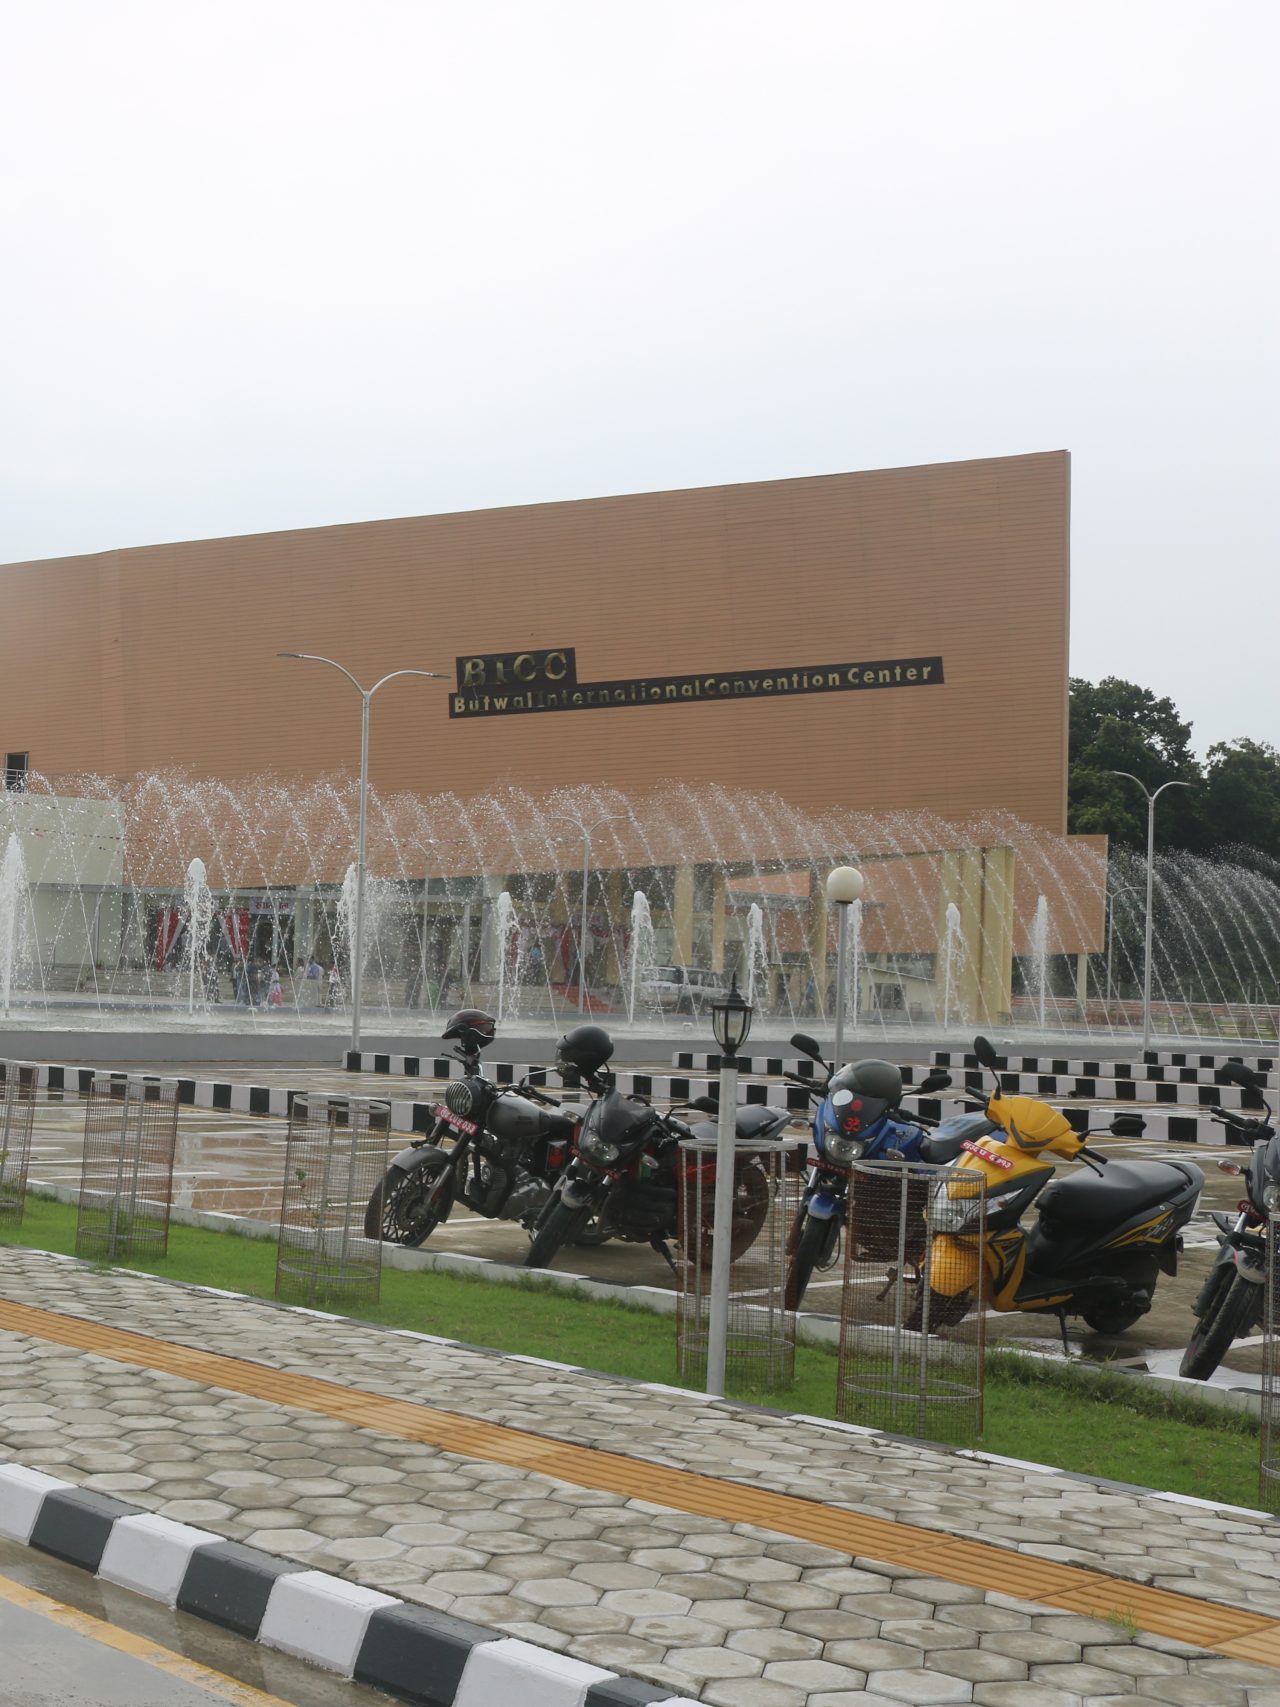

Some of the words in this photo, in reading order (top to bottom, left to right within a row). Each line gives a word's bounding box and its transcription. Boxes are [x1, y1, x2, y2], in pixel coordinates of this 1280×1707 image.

[463, 651, 568, 687] BICC
[703, 672, 841, 695] Convention
[847, 665, 933, 684] Center
